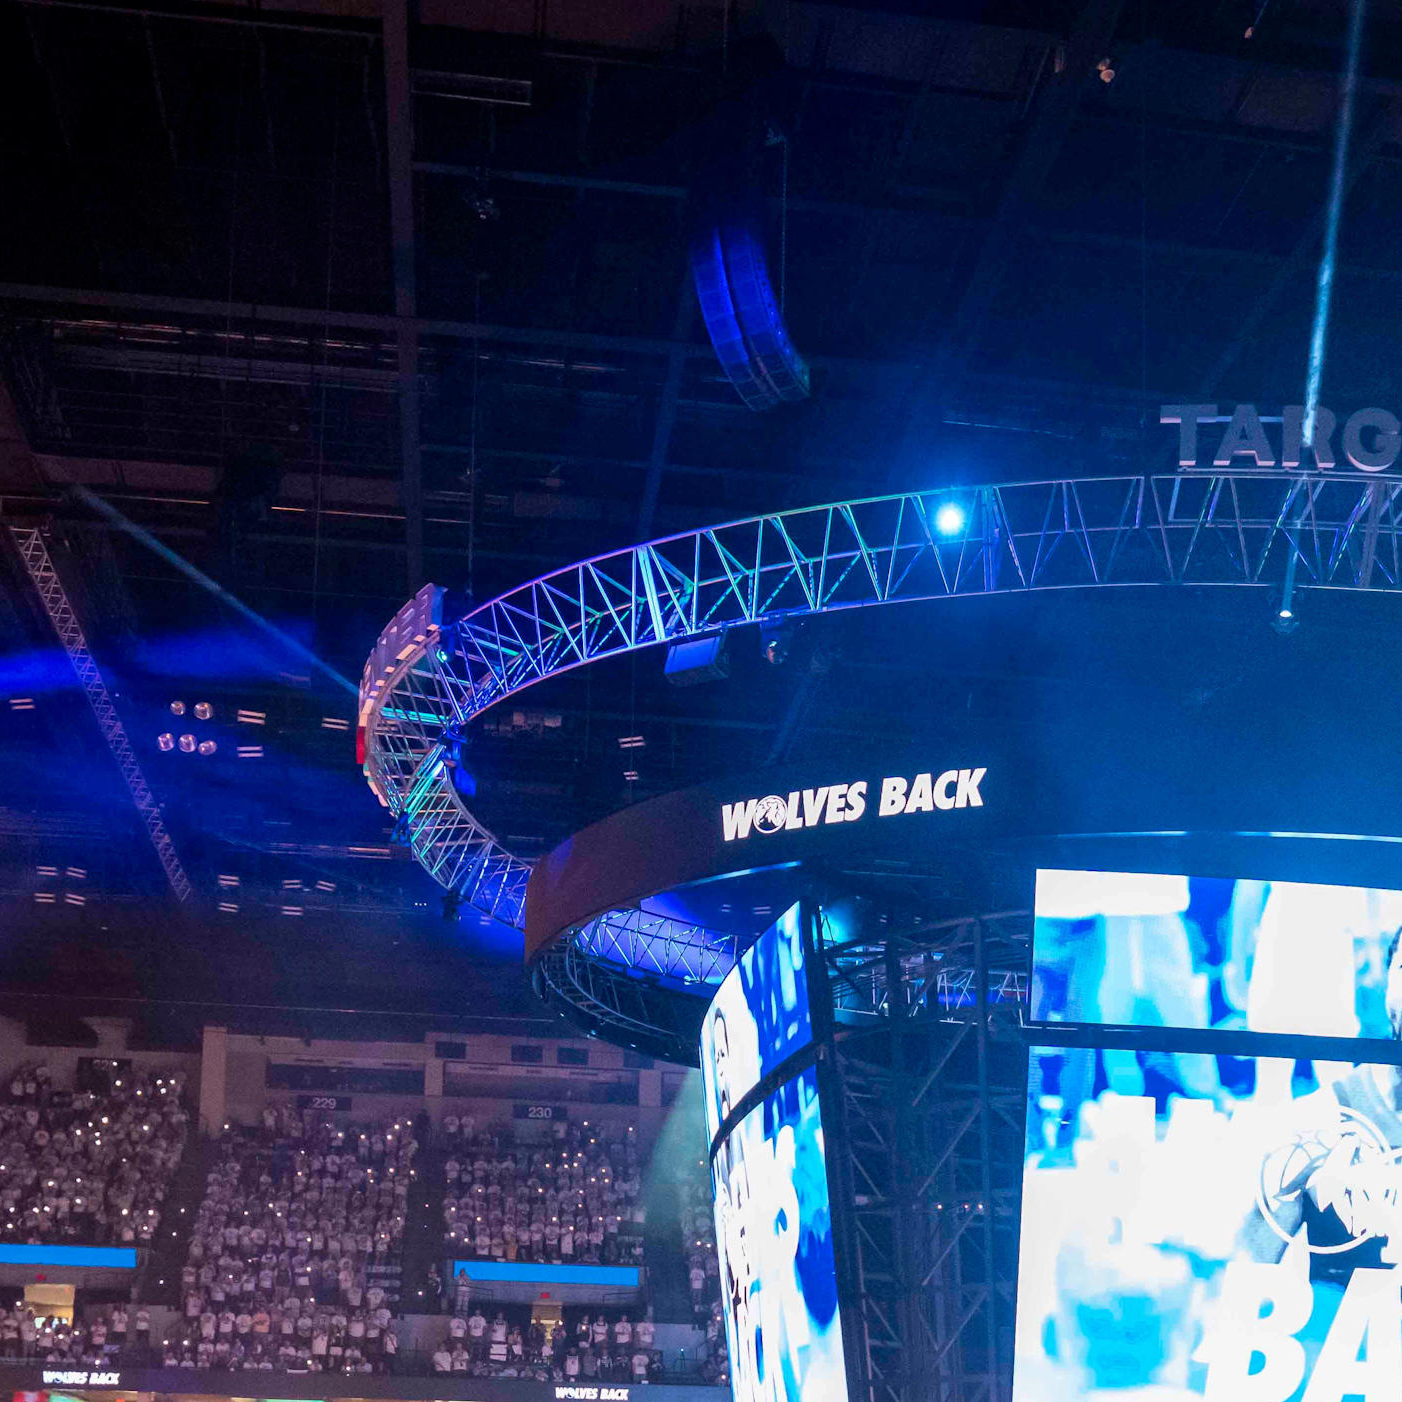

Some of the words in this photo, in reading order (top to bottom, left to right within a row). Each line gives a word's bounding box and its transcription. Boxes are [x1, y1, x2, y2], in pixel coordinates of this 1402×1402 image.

[722, 781, 866, 842] WOLVES
[878, 767, 987, 818] BACK
[313, 1097, 336, 1109] 229
[528, 1107, 553, 1118] 230
[89, 1372, 120, 1386] BACK
[555, 1386, 598, 1400] WOLVES
[599, 1388, 629, 1401] BACK
